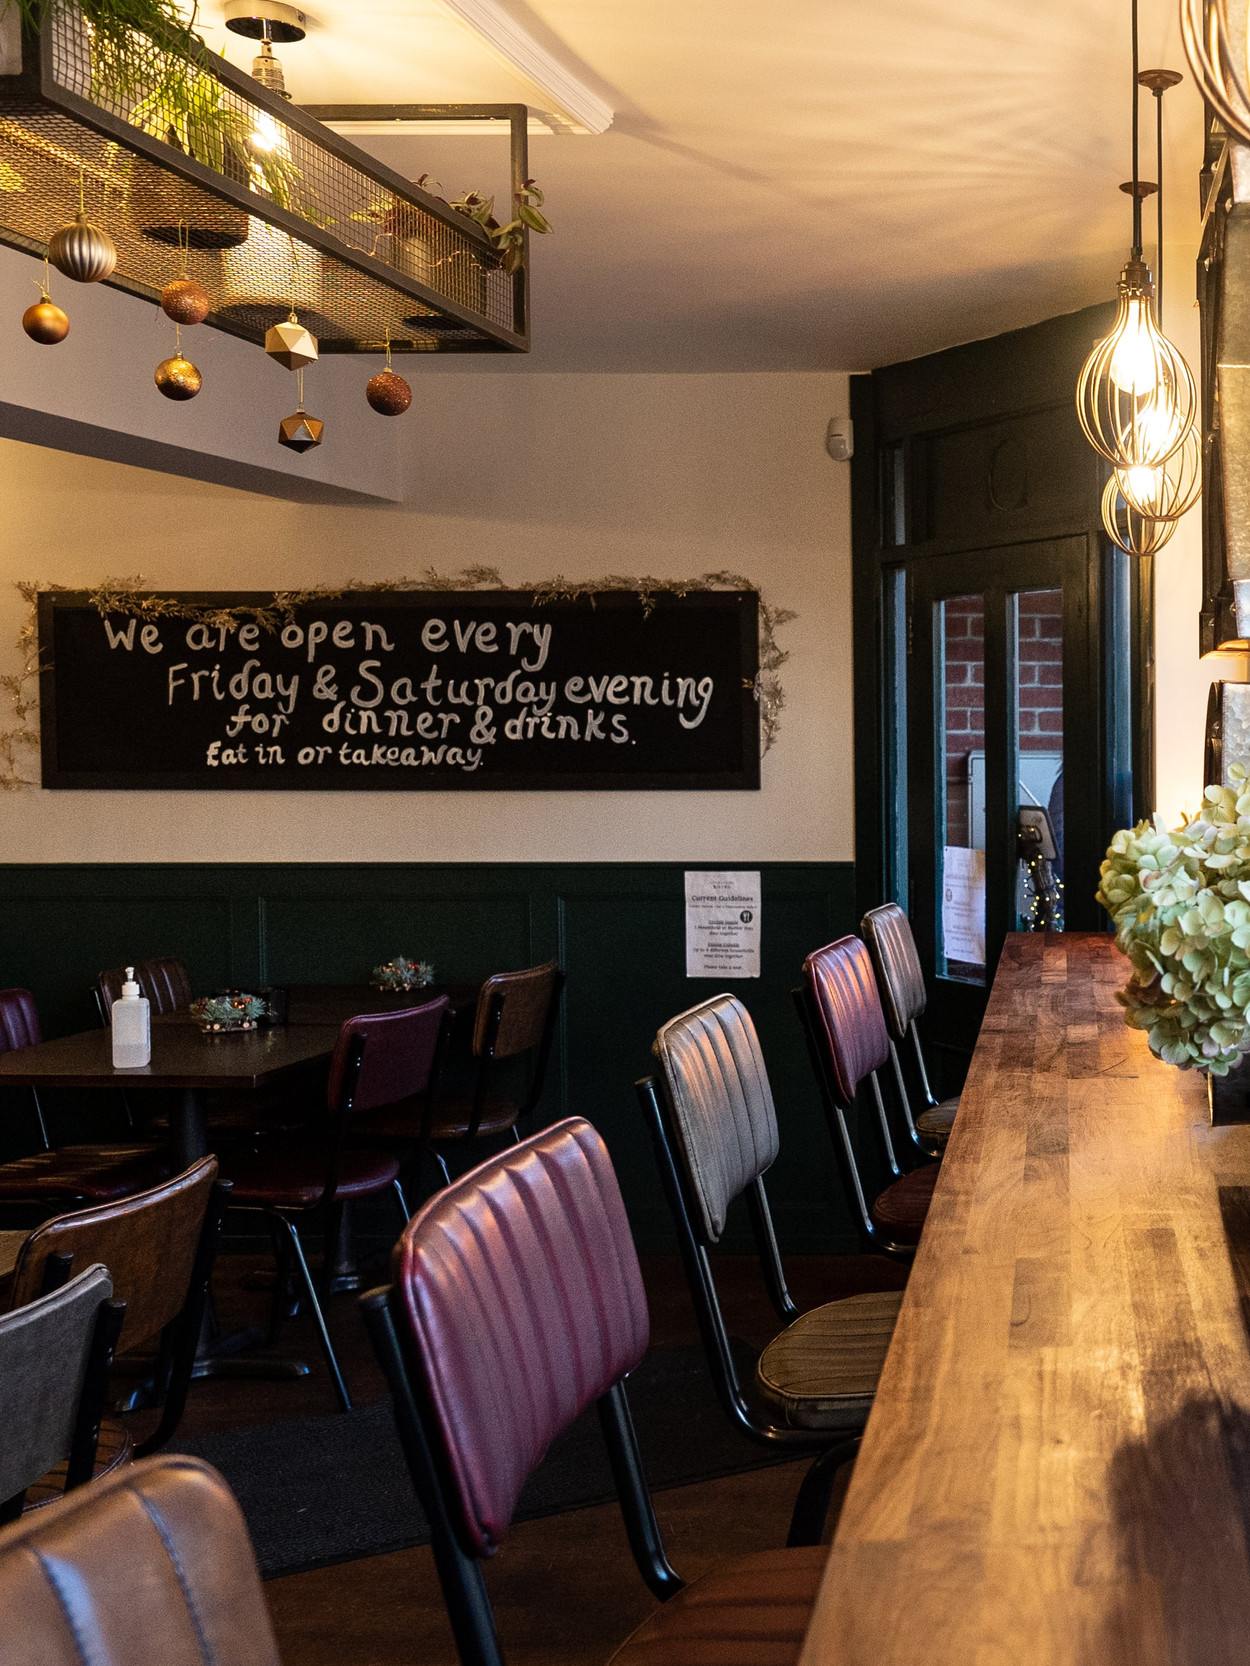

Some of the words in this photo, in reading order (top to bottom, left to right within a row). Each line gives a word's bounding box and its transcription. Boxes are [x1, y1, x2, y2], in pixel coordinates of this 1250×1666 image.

[104, 618, 163, 654] We
[186, 623, 260, 652] are
[281, 620, 395, 663] open
[421, 618, 552, 672] every
[168, 659, 299, 714] Friday
[312, 664, 339, 701] &
[350, 659, 556, 716] Saturday
[564, 672, 714, 730] evening
[226, 704, 290, 737] for
[322, 700, 461, 739] dinner
[470, 705, 497, 744] &
[504, 706, 636, 745] drinks.
[206, 741, 248, 766] Eat
[255, 743, 285, 765] in
[298, 745, 332, 766] or
[339, 742, 484, 771] takeaway.
